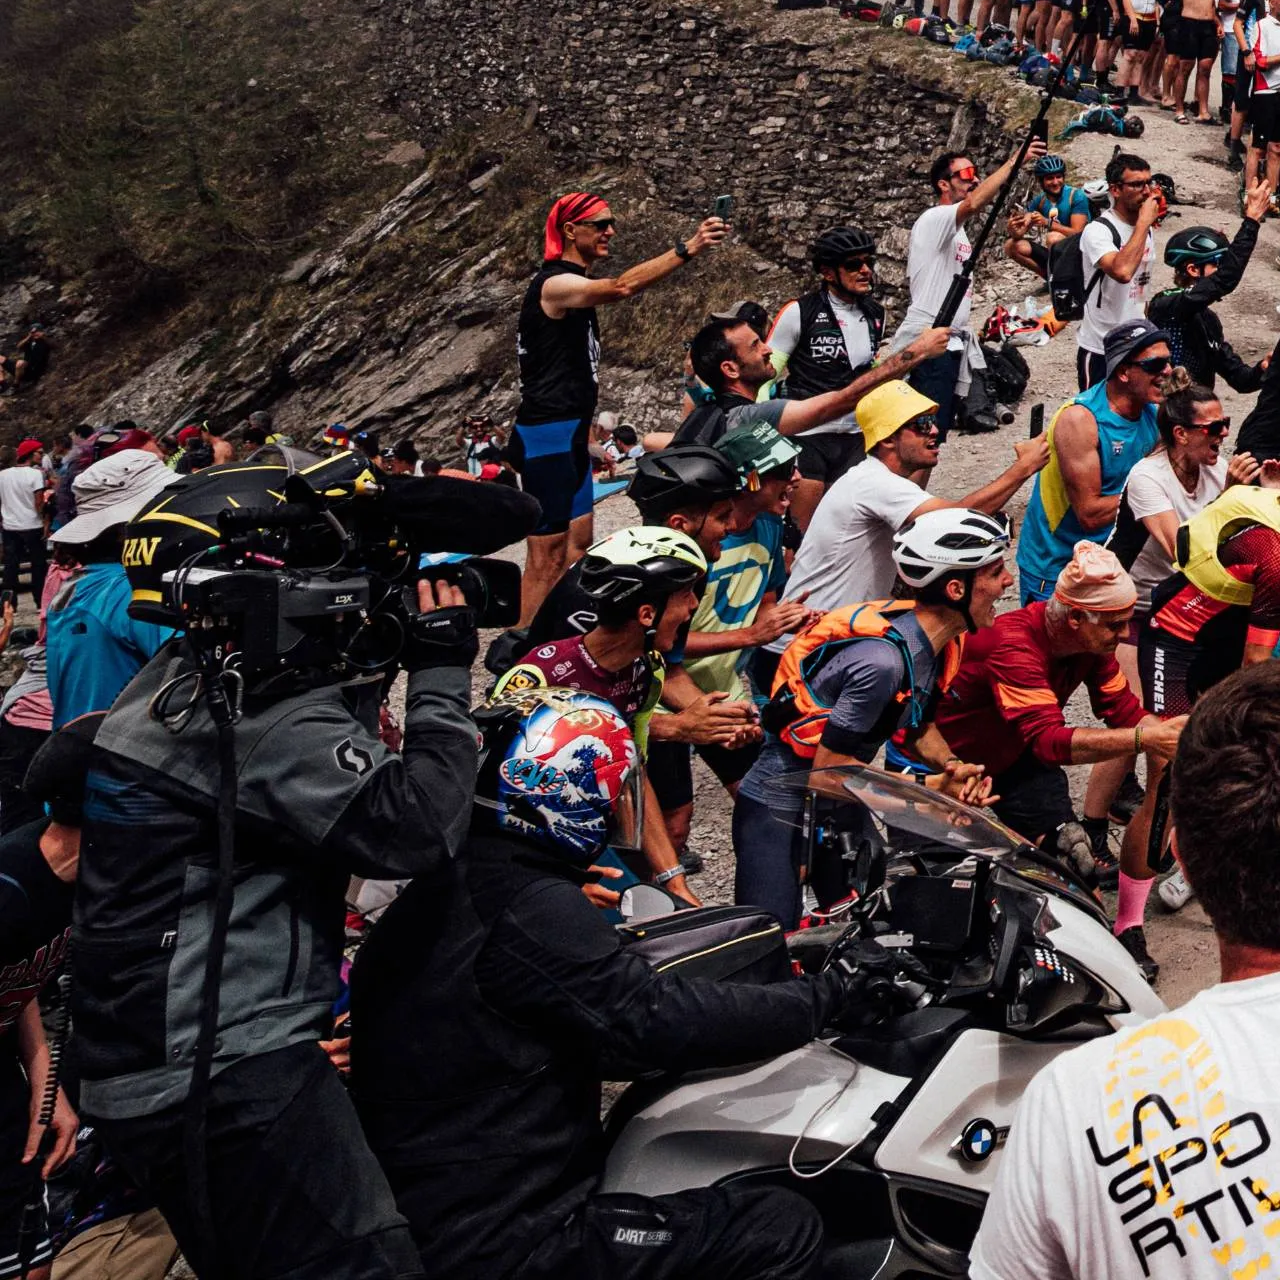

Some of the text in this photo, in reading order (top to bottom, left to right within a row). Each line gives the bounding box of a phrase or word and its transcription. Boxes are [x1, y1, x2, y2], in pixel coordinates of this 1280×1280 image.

[630, 539, 683, 558] MET
[1154, 647, 1166, 713] MICHEL
[1086, 1094, 1181, 1167] LA
[1108, 1112, 1271, 1226] SPO
[615, 1227, 648, 1244] DIRT
